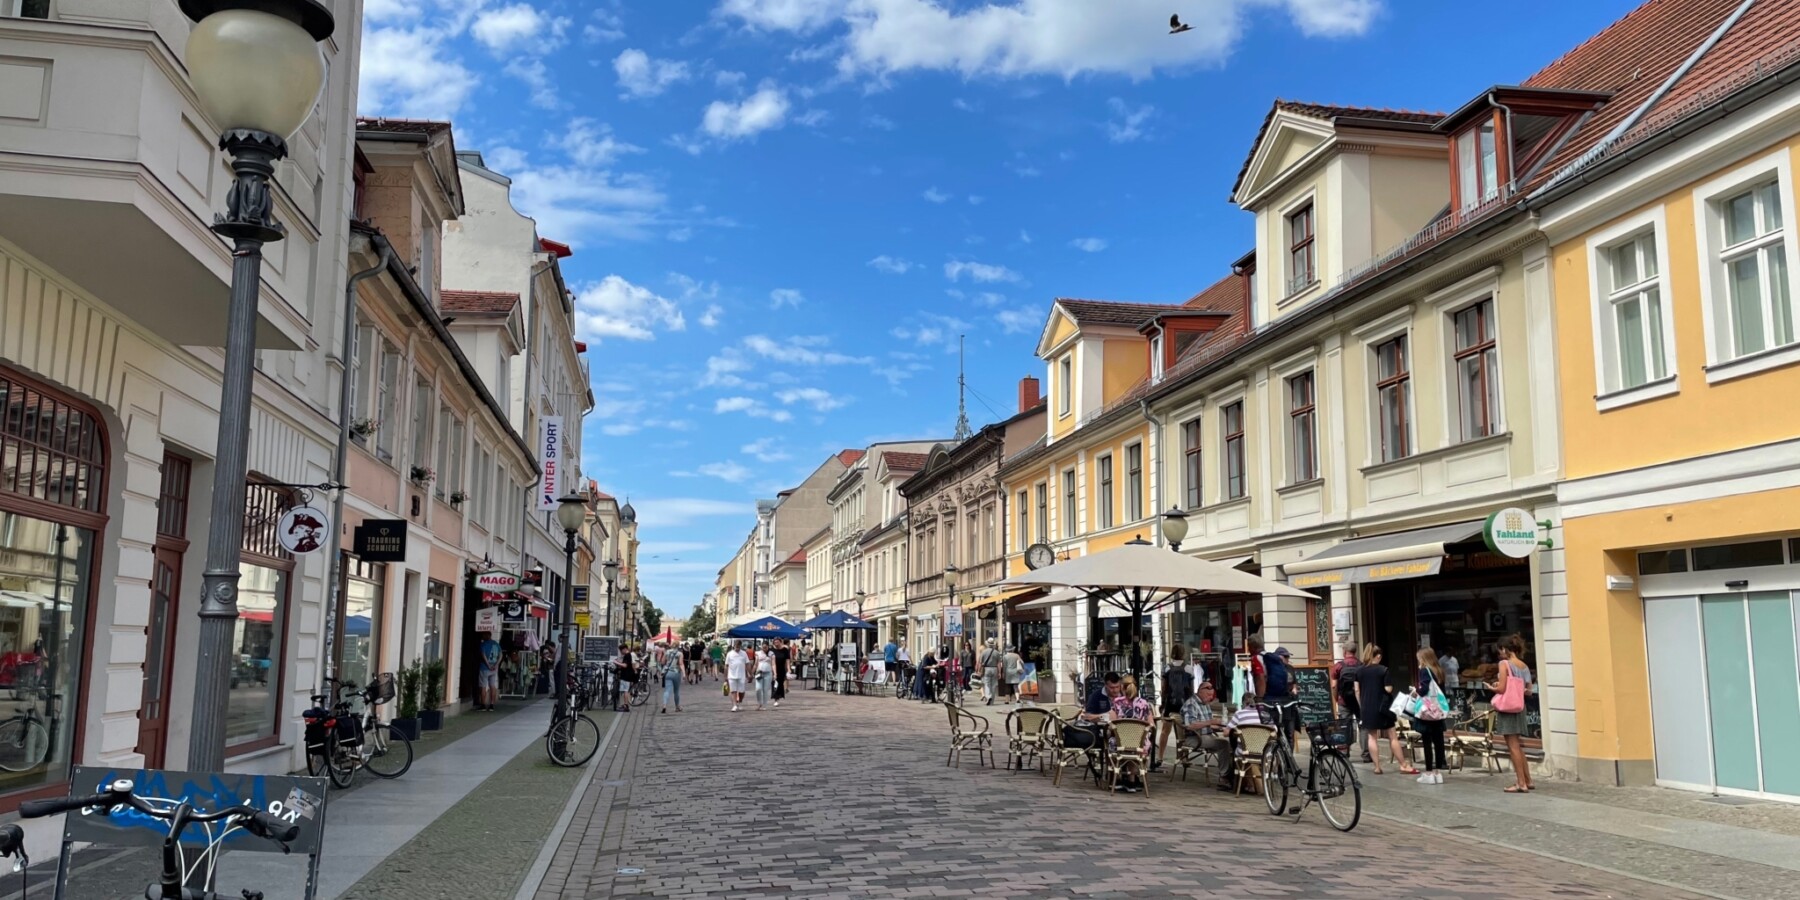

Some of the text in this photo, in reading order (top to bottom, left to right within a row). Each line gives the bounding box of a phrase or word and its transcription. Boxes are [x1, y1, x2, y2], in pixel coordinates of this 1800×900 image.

[544, 422, 557, 493] INTER SPORT
[1496, 530, 1535, 538] Fahland
[480, 576, 516, 585] MAGO
